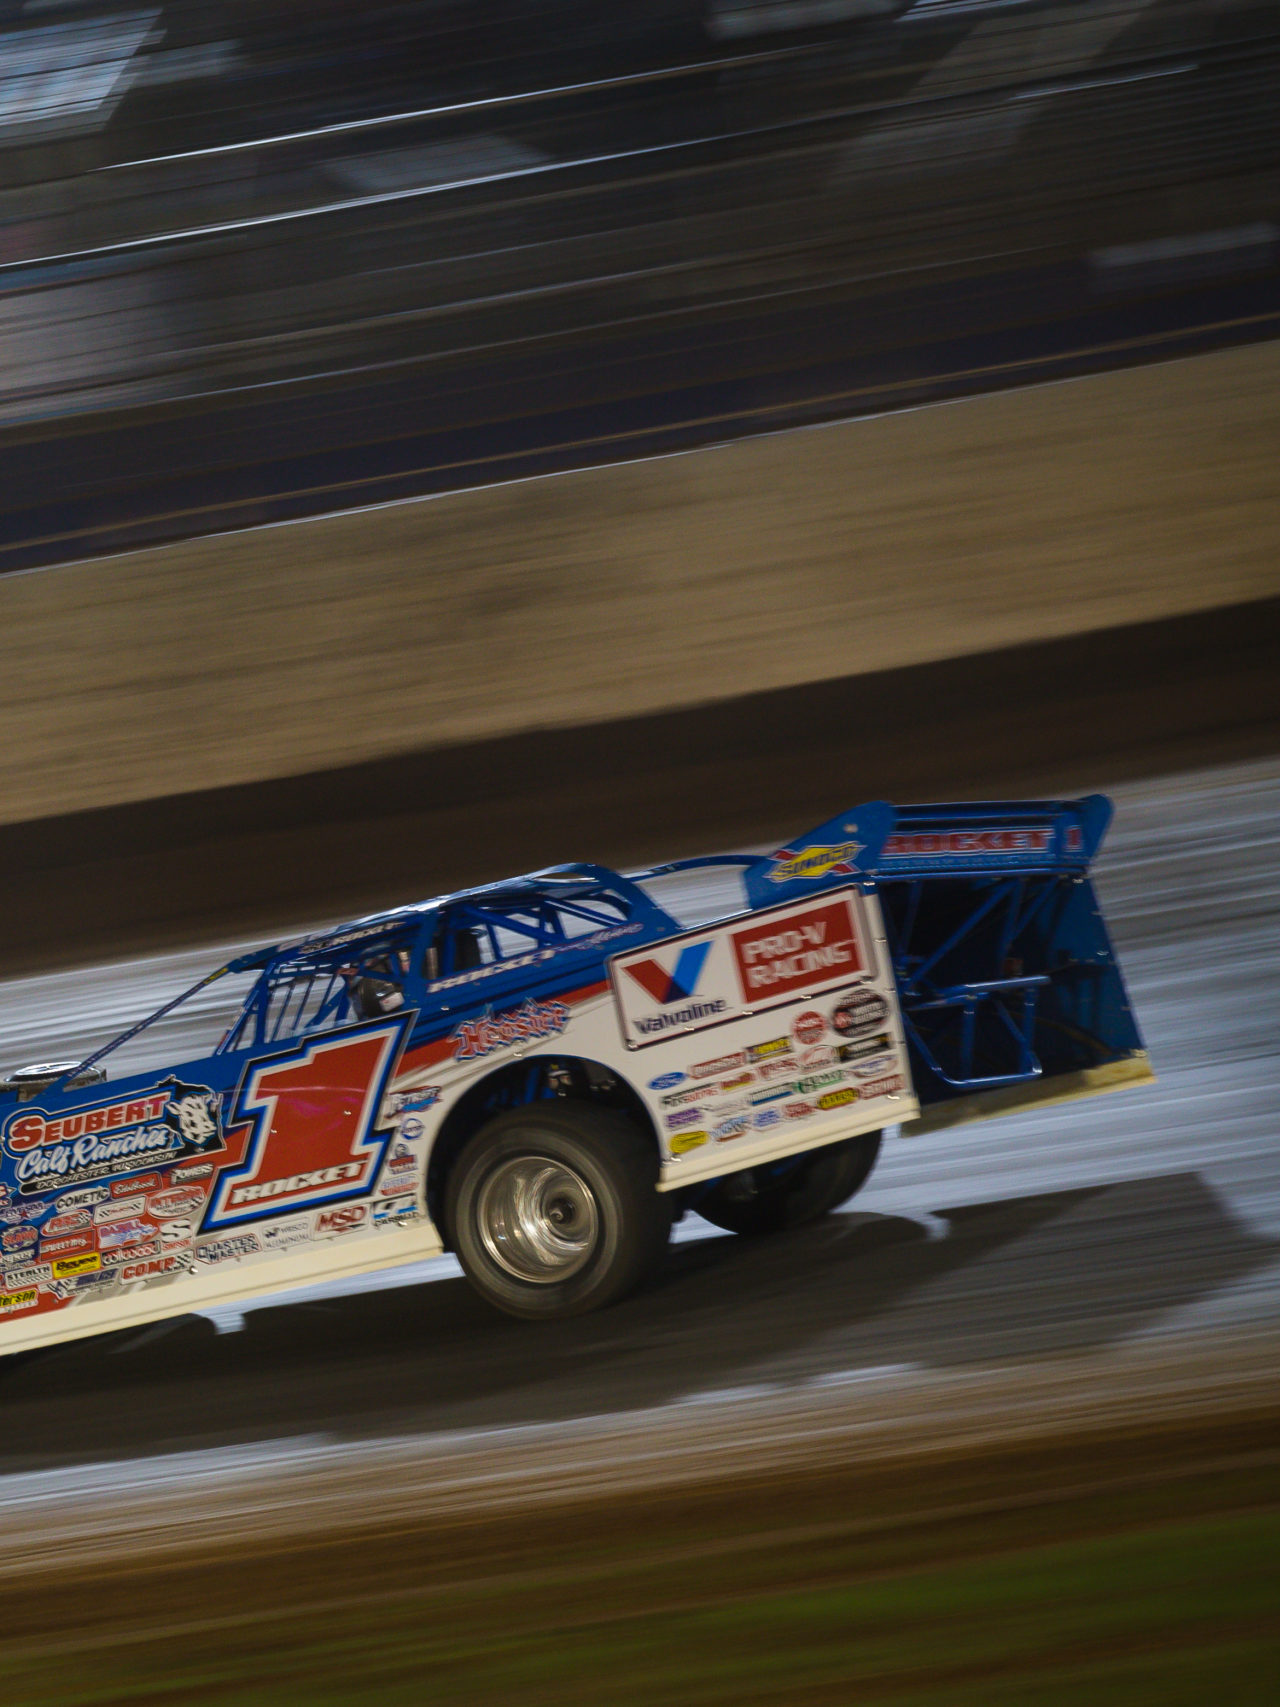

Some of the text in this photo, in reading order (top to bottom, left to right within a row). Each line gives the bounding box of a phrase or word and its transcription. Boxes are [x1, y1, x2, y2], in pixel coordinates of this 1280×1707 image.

[776, 843, 860, 876] SUNOCO
[885, 828, 1054, 855] ROCKET
[740, 920, 828, 964] PRO-V
[746, 943, 853, 989] RACING
[632, 999, 726, 1034] Valvoline
[9, 1092, 170, 1151] SEUBERT
[212, 1026, 401, 1222] 1
[20, 1127, 169, 1180] Calf Ranches
[56, 1187, 110, 1209] COMETIC
[230, 1159, 371, 1206] ROCKET
[315, 1206, 366, 1232] MSD
[122, 1256, 176, 1280] COMP
